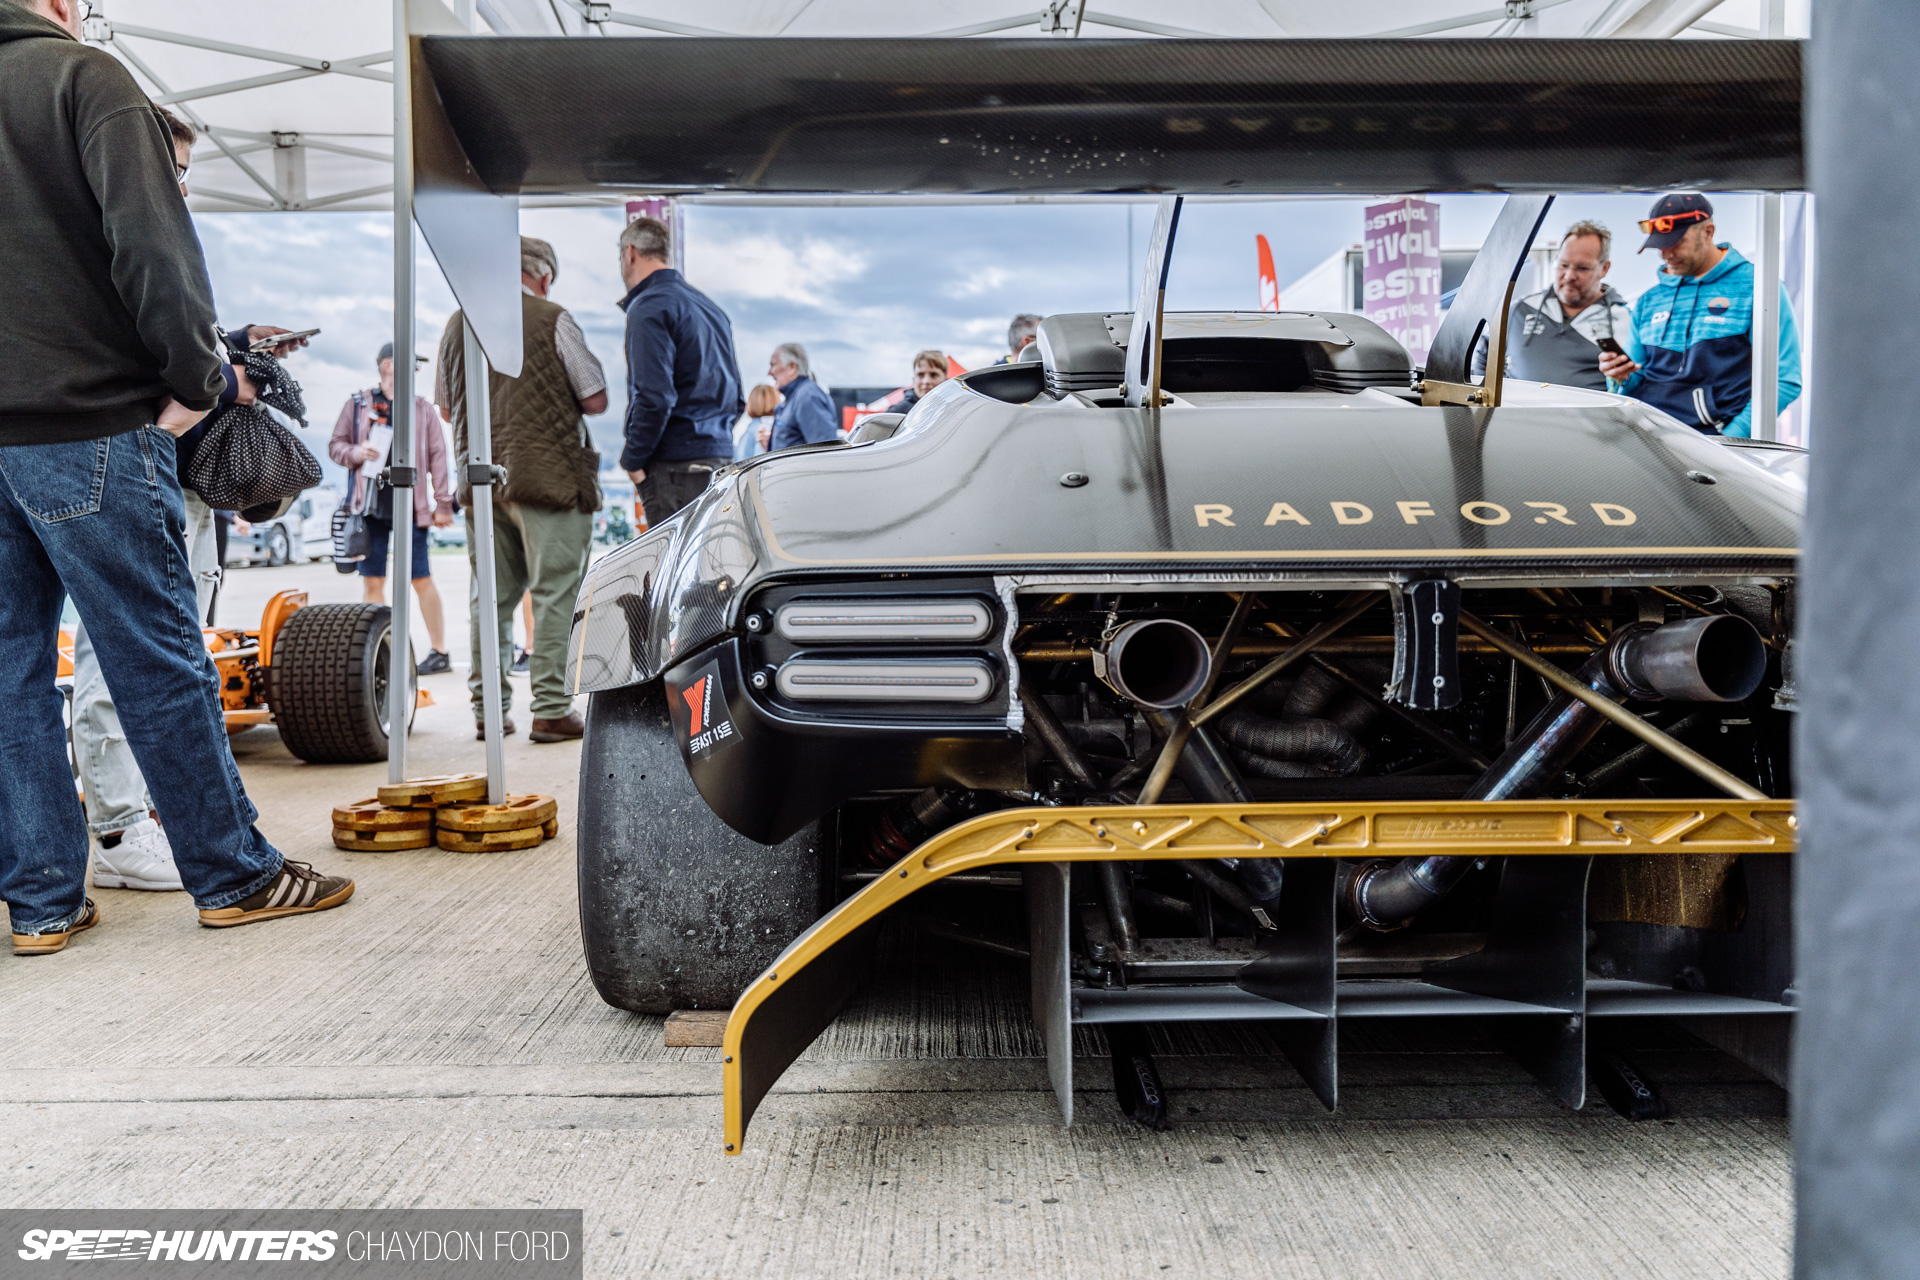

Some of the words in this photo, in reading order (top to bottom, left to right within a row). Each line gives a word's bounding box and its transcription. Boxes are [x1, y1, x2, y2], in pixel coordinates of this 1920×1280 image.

[1194, 500, 1637, 527] RADFORD
[696, 730, 713, 751] FAST
[713, 725, 724, 741] 15
